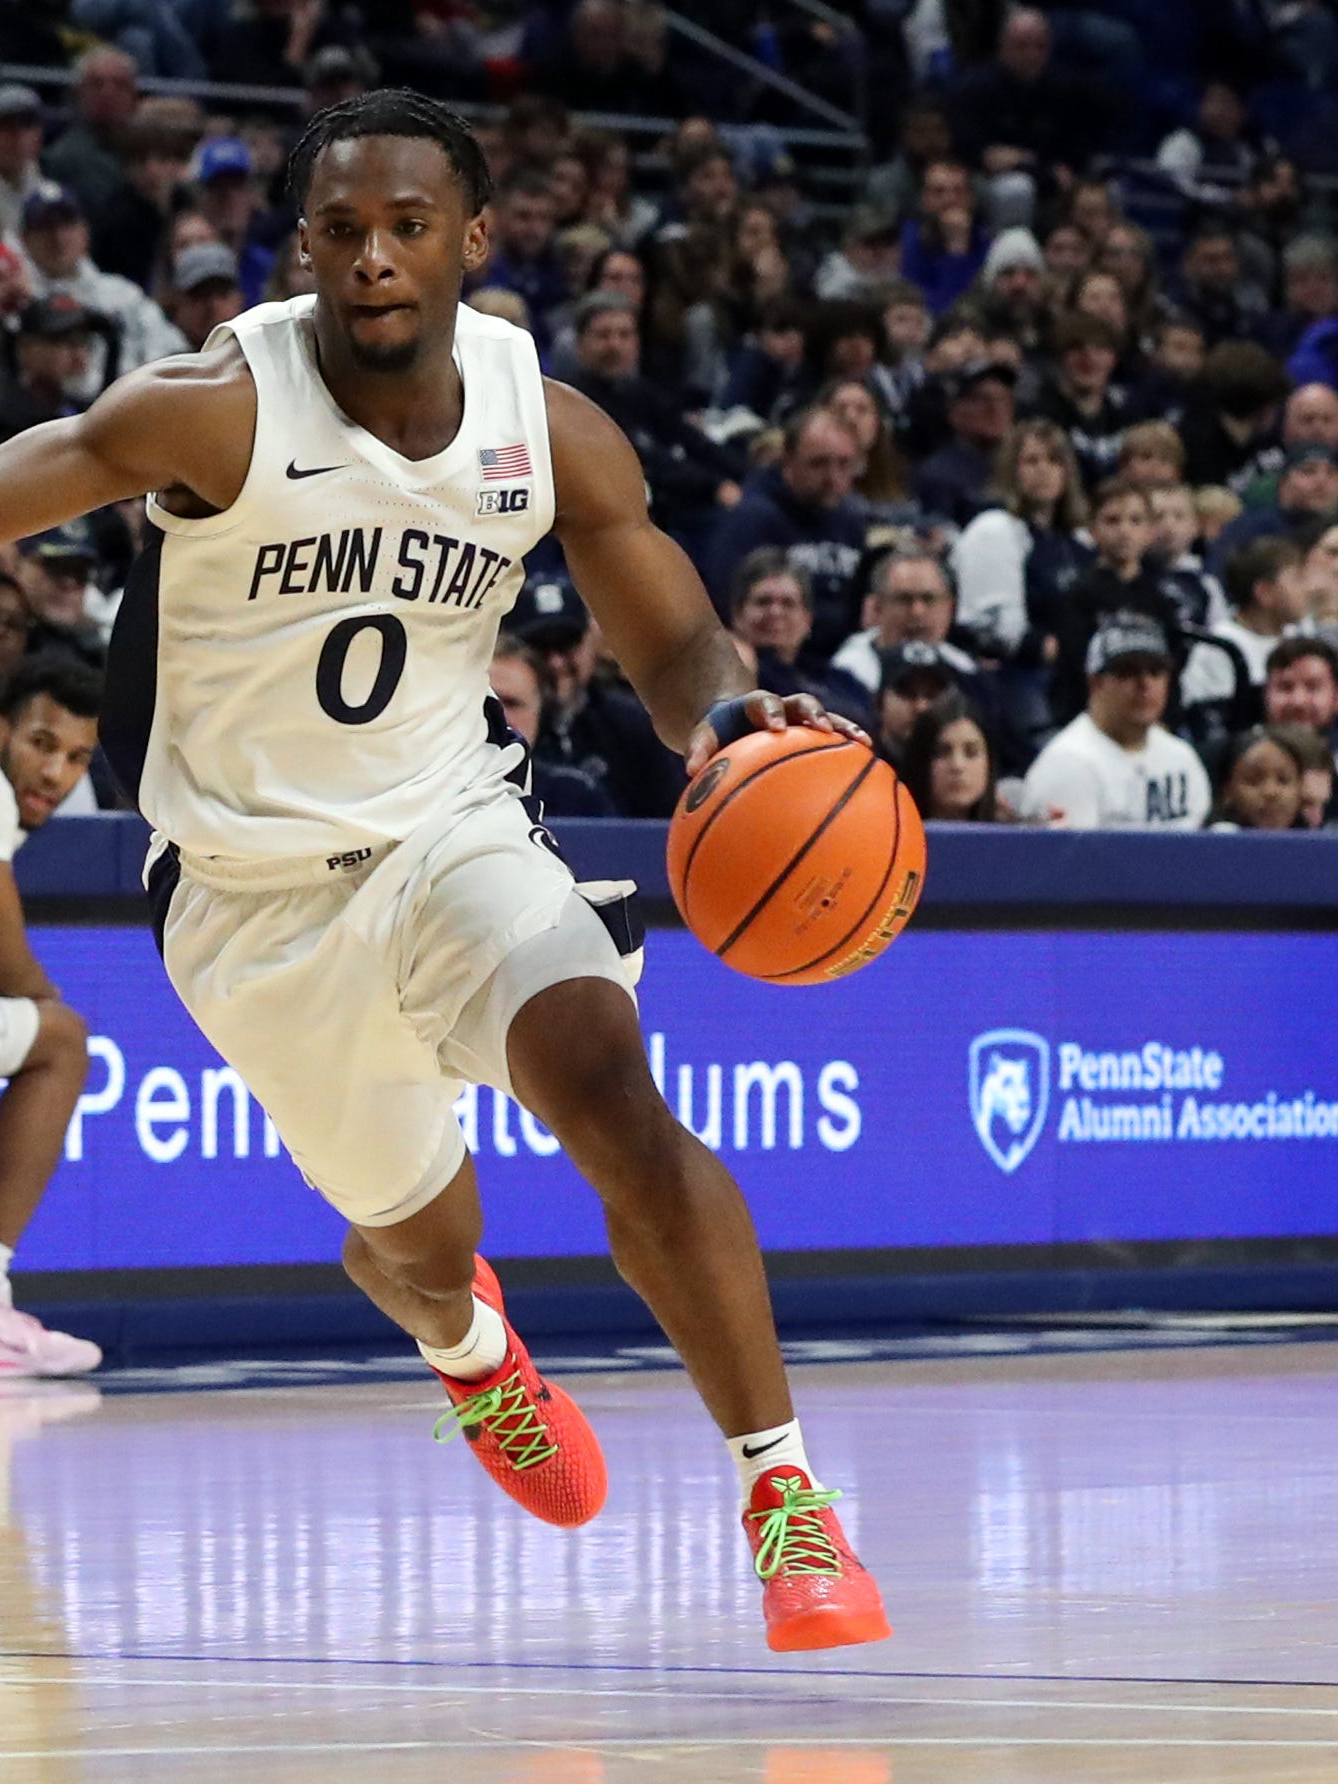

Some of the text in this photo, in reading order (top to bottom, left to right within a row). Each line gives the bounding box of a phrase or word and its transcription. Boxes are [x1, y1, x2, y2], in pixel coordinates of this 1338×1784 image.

[248, 527, 383, 600] PENN
[391, 528, 512, 609] STATE
[315, 613, 408, 726] 0
[325, 846, 373, 871] PSU
[1058, 1041, 1224, 1091] PennState
[1058, 1092, 1173, 1141] Alumni
